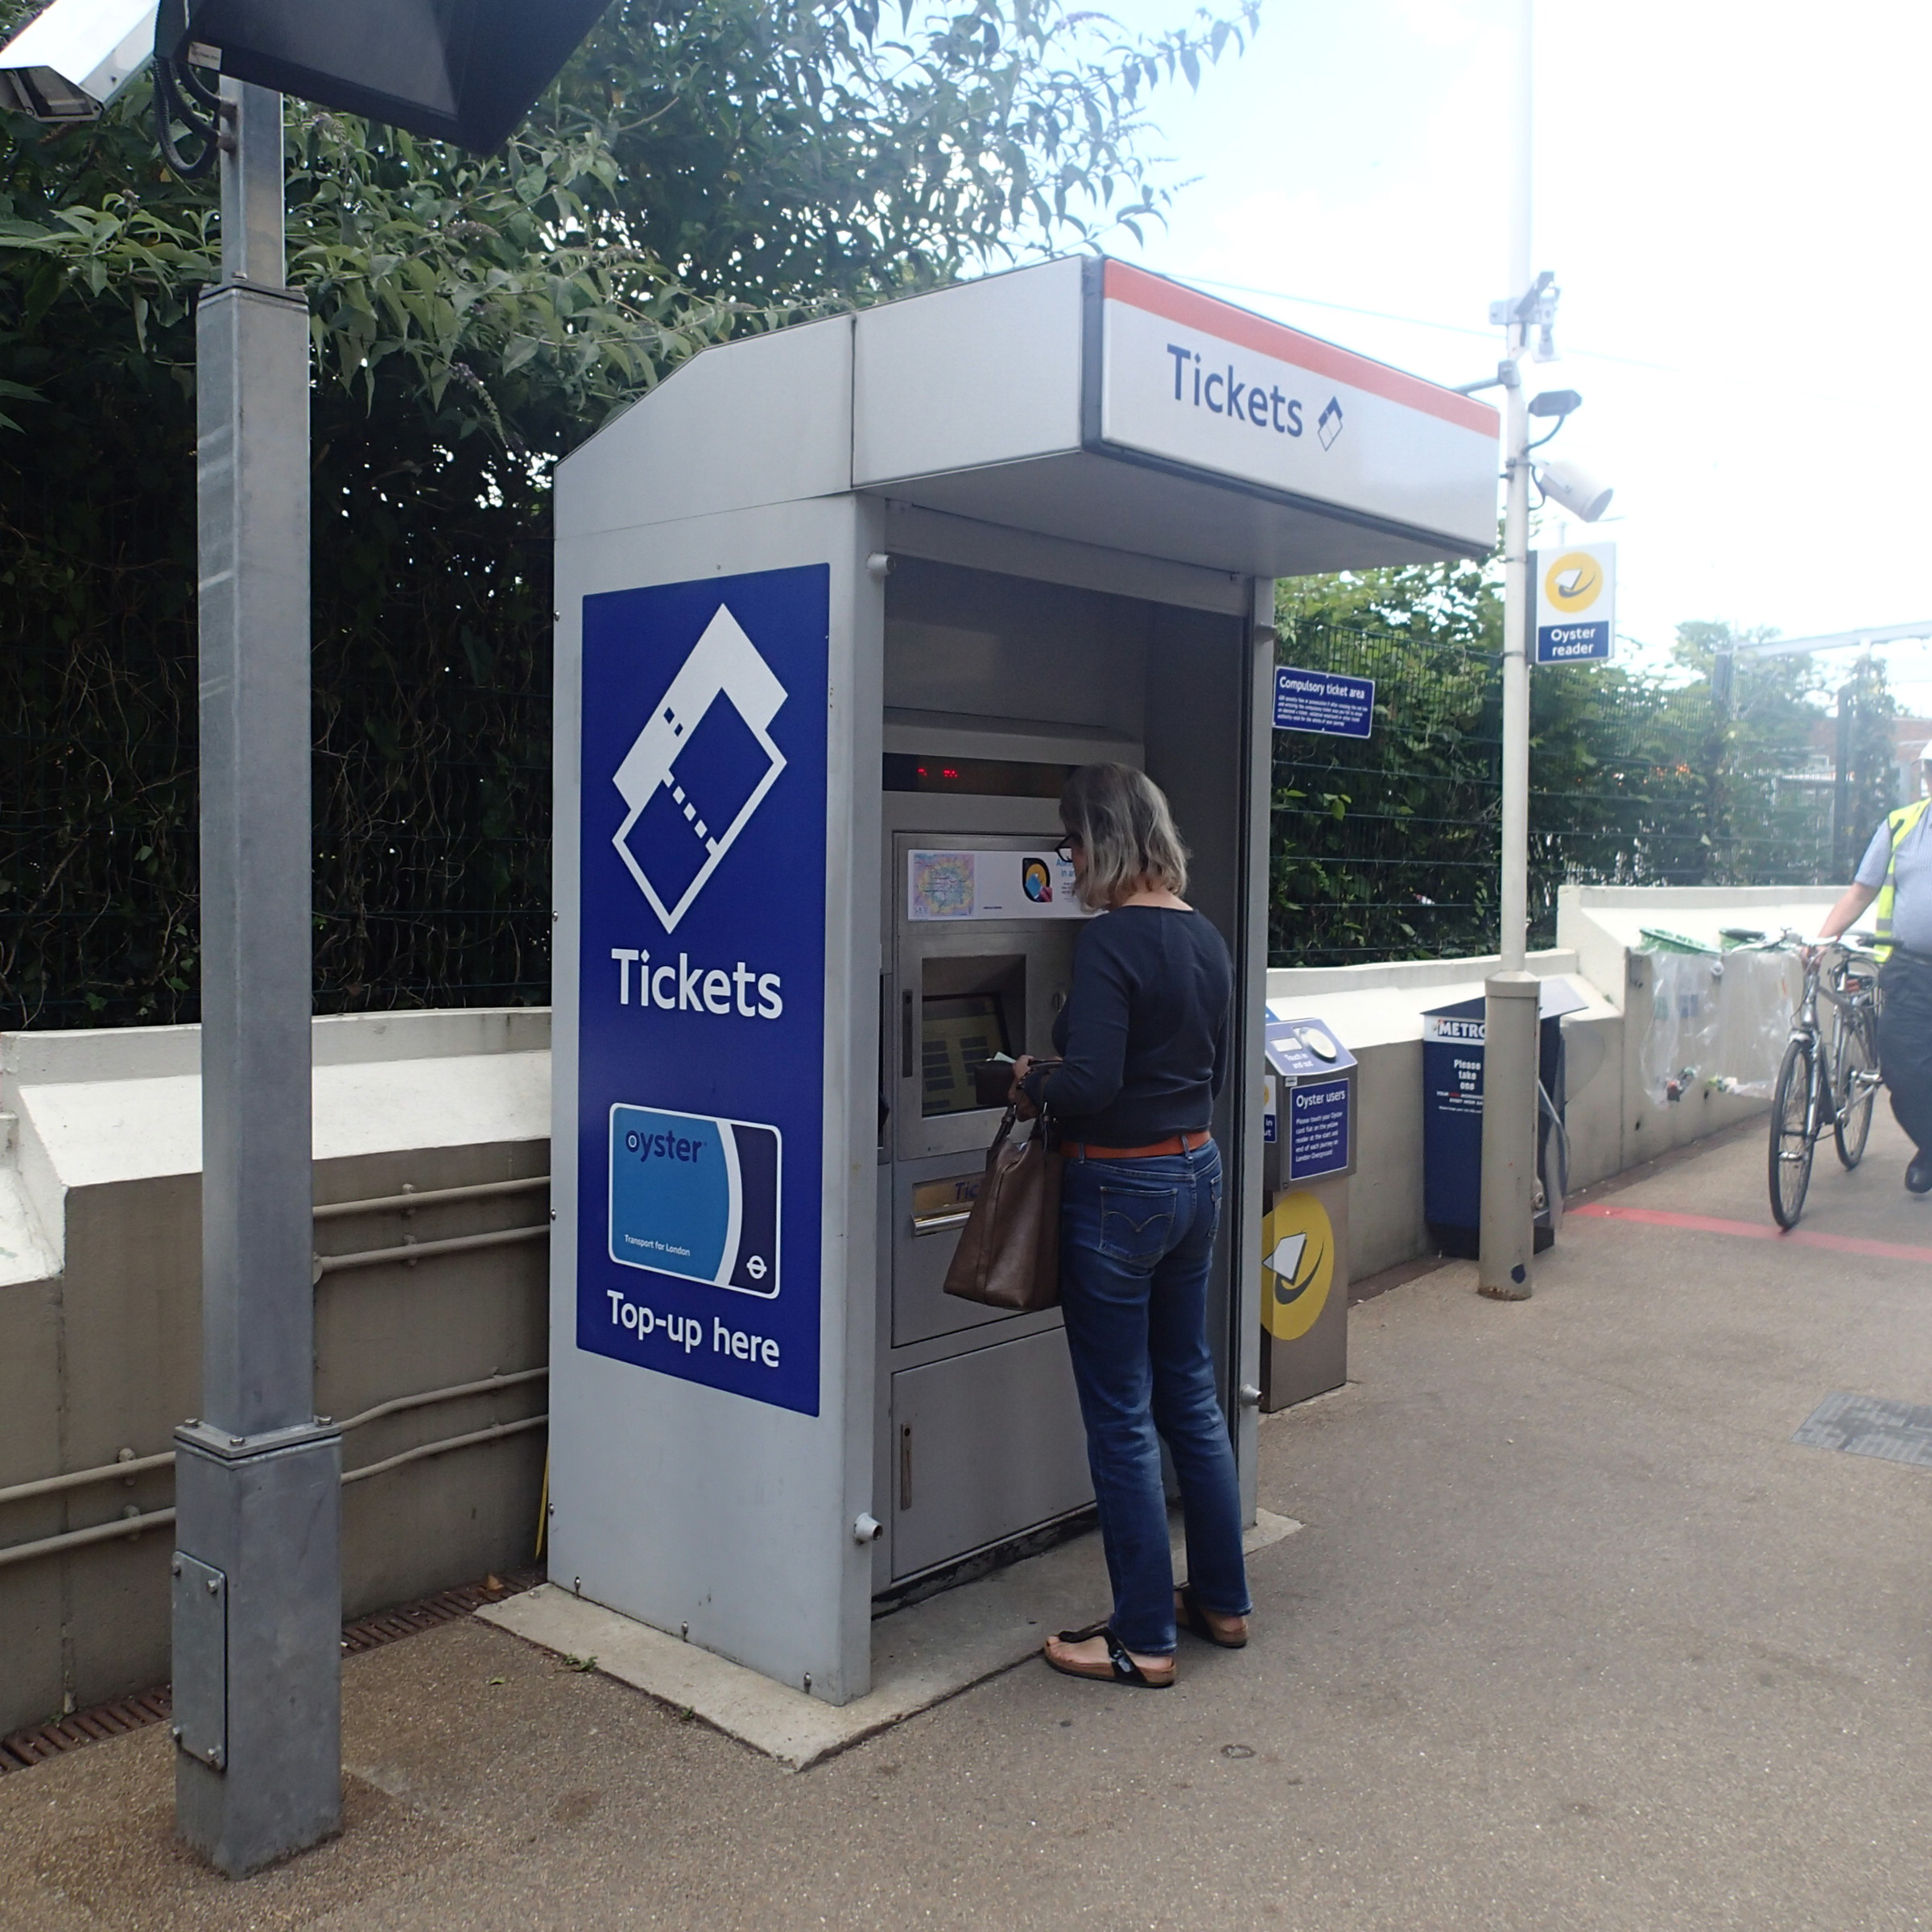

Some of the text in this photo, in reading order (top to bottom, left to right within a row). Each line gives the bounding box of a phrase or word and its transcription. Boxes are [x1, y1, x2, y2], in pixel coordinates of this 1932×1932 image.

[1166, 343, 1303, 437] Tickets
[1550, 628, 1596, 643] Oyster
[1552, 642, 1594, 657] reader
[1279, 676, 1364, 700] Compulsory ticket area
[611, 948, 783, 1019] Tickets
[1454, 1059, 1481, 1071] Please
[1459, 1071, 1477, 1080] take
[1460, 1082, 1475, 1091] one
[1296, 1090, 1345, 1110] Oyster users
[625, 1129, 703, 1163] oyster
[625, 1234, 691, 1257] Transport for London
[606, 1289, 780, 1368] Top-up here
